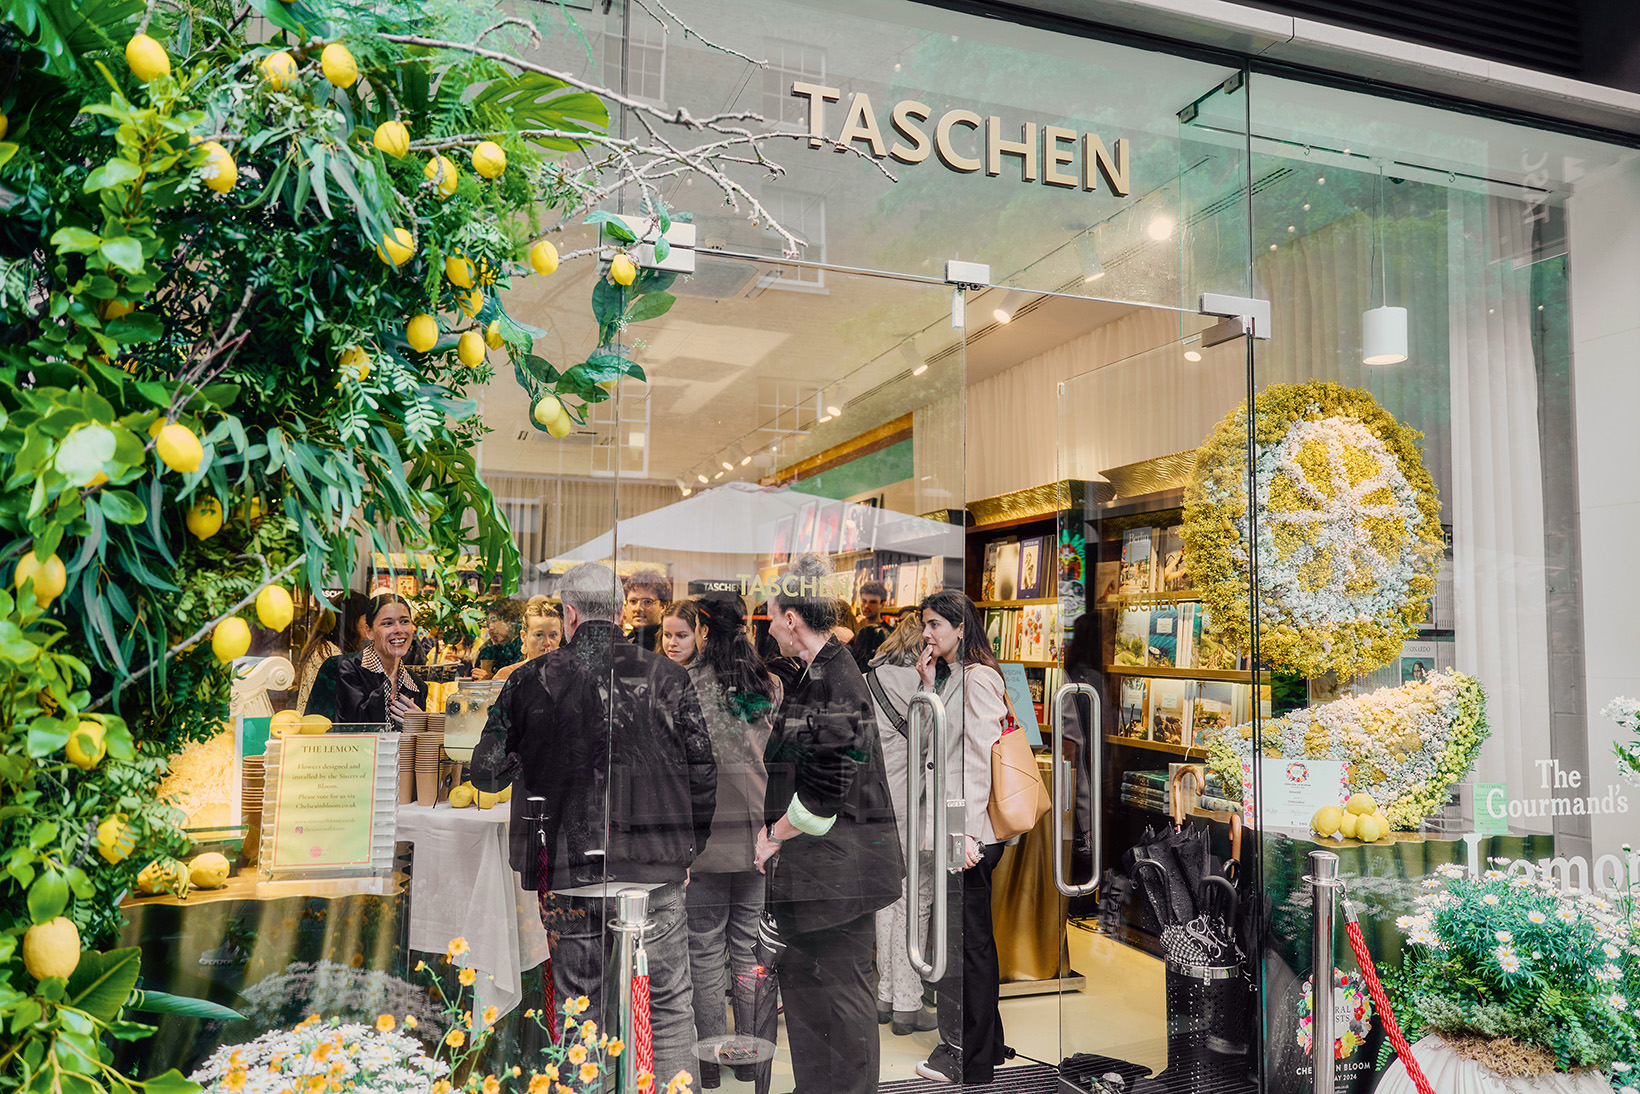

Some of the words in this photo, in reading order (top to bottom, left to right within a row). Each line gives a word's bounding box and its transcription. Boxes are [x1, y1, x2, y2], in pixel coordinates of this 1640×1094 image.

[791, 81, 1130, 198] TASCHEN
[736, 574, 849, 598] TASCHEN
[302, 745, 321, 753] THE
[322, 763, 348, 771] designed
[319, 773, 326, 781] by
[1535, 759, 1582, 789] The
[1343, 1062, 1371, 1071] BLOOM
[1343, 1073, 1357, 1081] 2024
